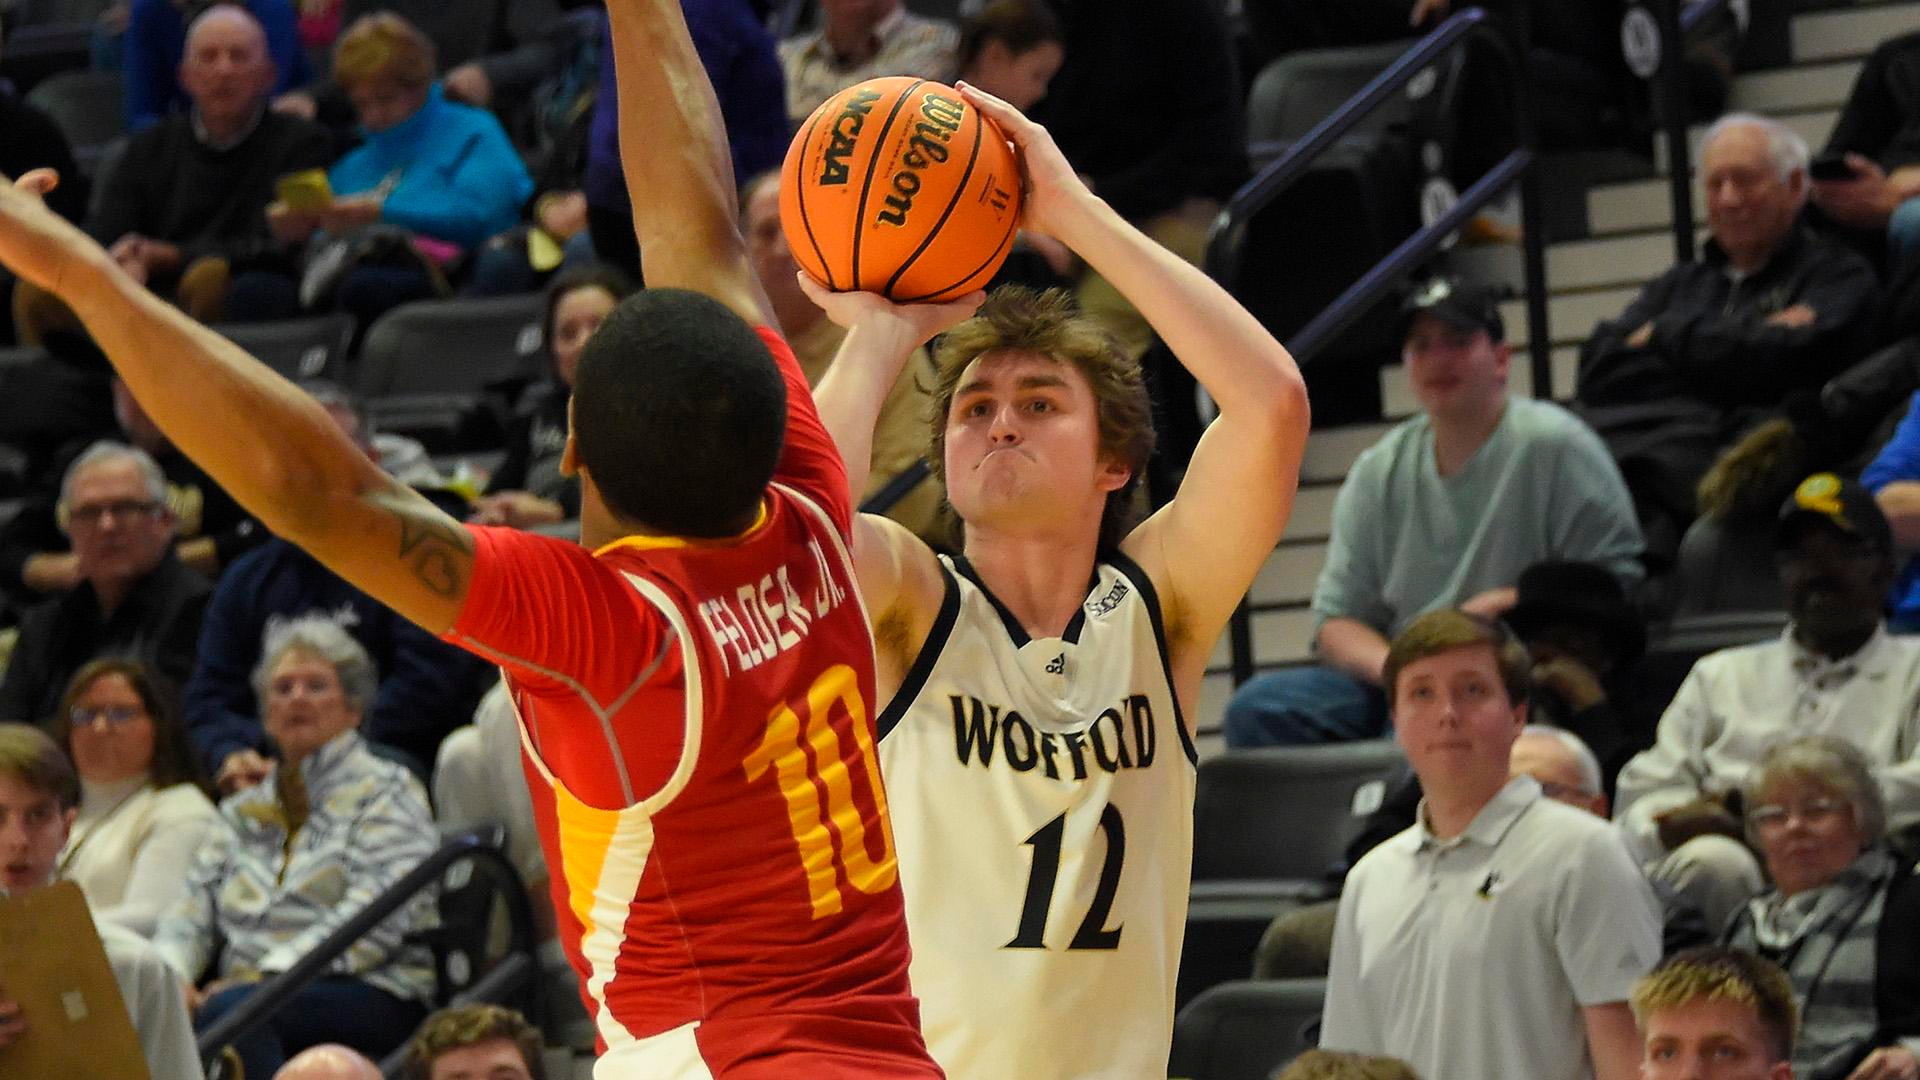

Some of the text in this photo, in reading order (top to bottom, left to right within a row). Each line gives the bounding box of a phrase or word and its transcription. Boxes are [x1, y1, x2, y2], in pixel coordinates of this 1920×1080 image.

[819, 91, 881, 185] NCAA
[879, 94, 966, 227] Wilson
[699, 564, 812, 678] FELDER
[743, 664, 897, 919] 10
[1001, 801, 1124, 951] 12
